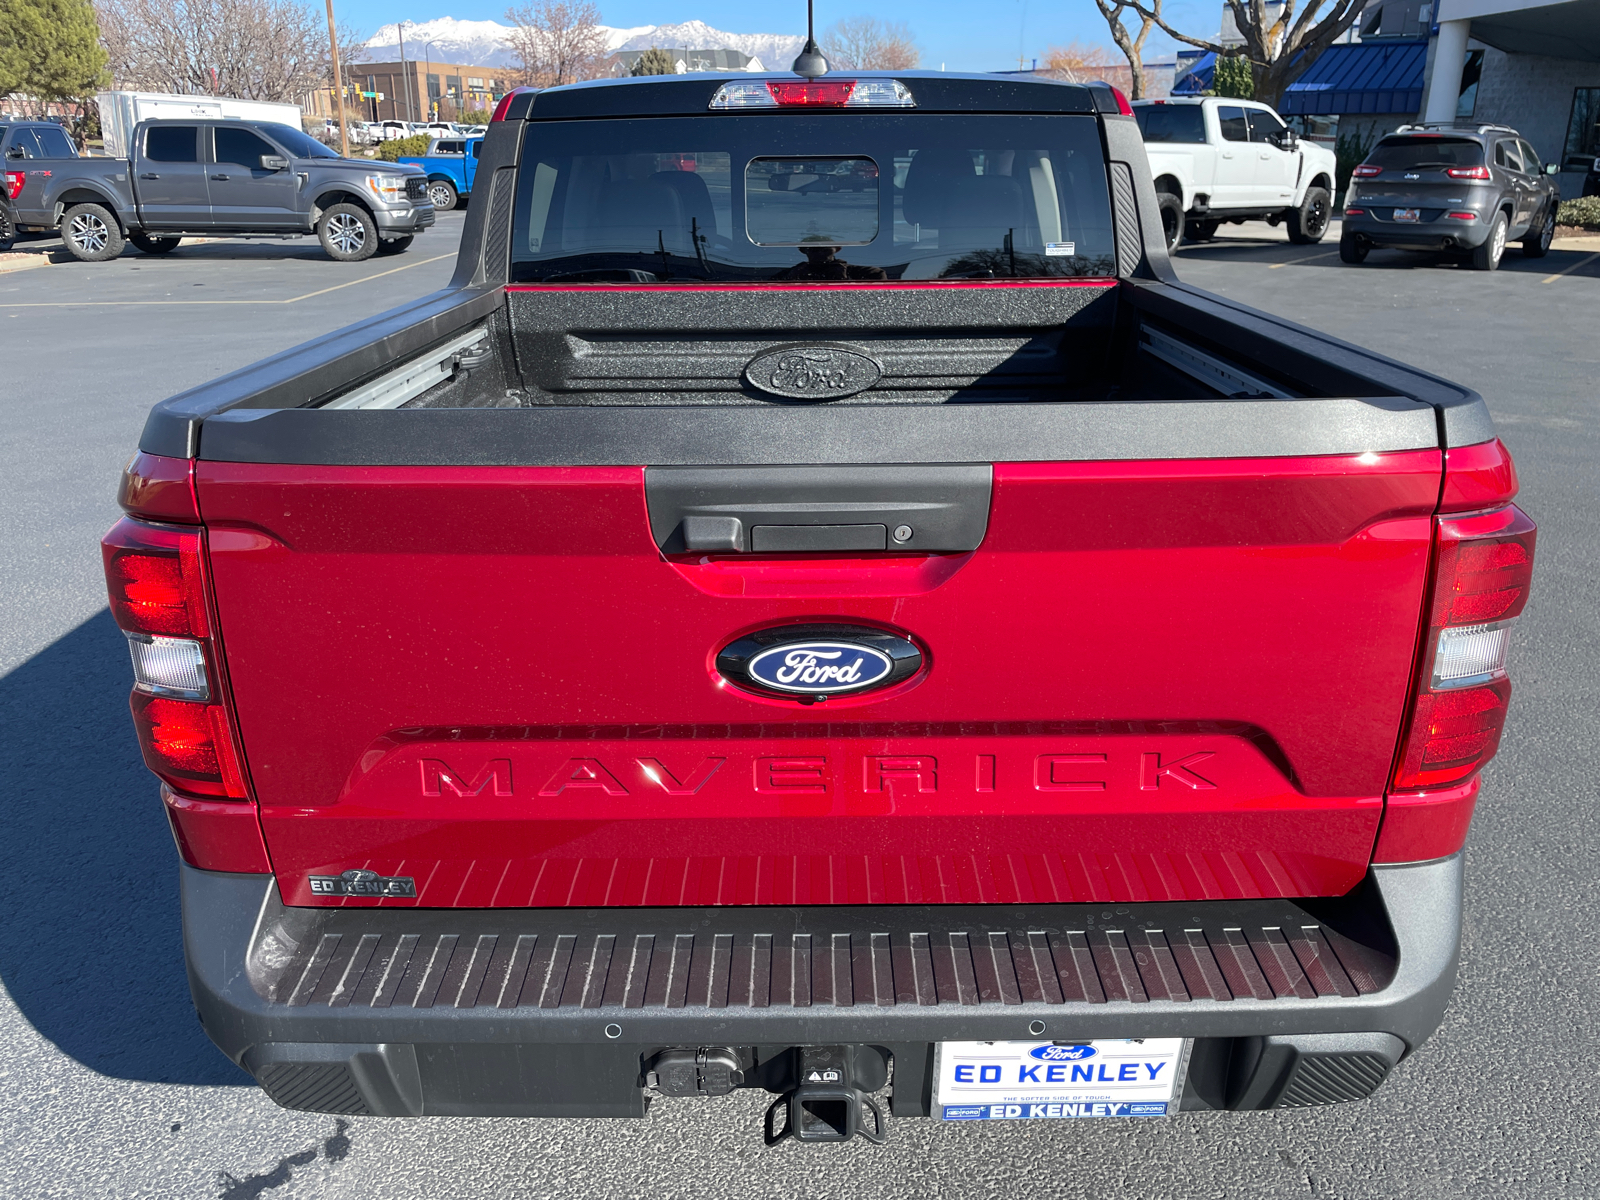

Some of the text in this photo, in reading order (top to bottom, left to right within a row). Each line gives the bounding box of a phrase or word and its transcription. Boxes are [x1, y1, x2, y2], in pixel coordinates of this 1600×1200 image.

[769, 355, 858, 389] Ford
[776, 649, 865, 683] Ford
[420, 751, 1219, 797] MAVERICK
[310, 880, 413, 893] ED KENLEY
[1041, 1044, 1084, 1060] Ford
[954, 1062, 1167, 1083] ED KENLEY
[989, 1105, 1022, 1118] ED
[1029, 1103, 1123, 1118] KENLEY
